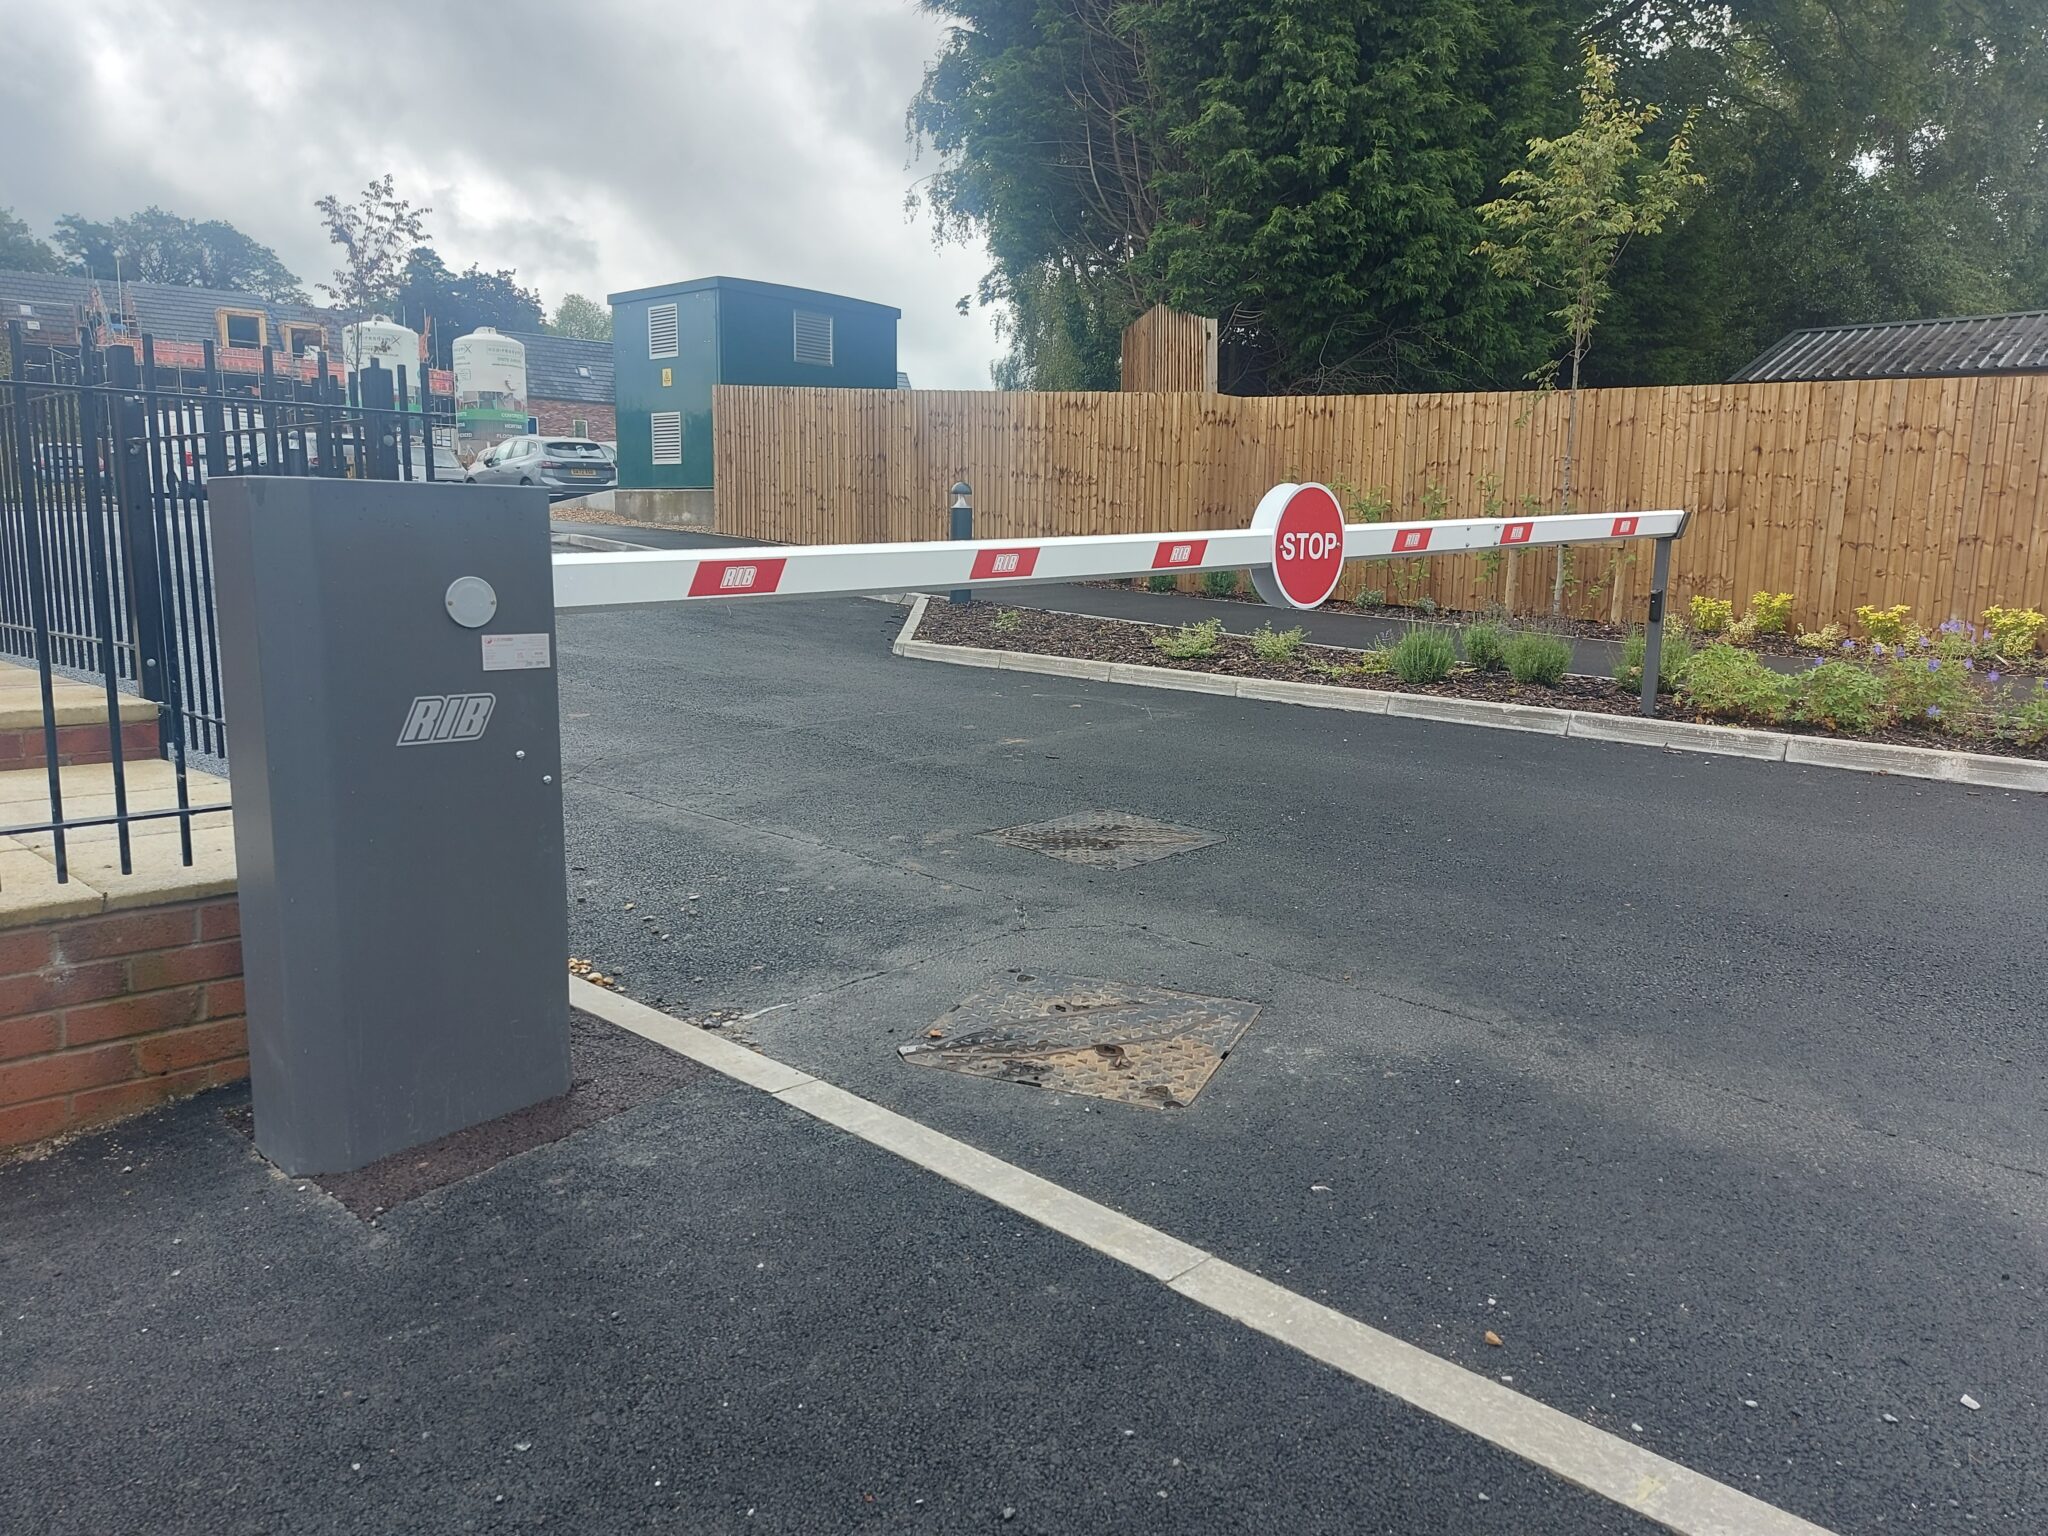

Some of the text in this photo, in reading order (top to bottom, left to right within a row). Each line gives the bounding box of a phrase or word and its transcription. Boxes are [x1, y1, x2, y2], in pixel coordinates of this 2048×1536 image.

[1170, 544, 1192, 562] RIB
[1282, 532, 1337, 561] STOP
[992, 554, 1019, 573] RIB
[720, 565, 757, 588] RIB
[397, 693, 496, 746] RIB
